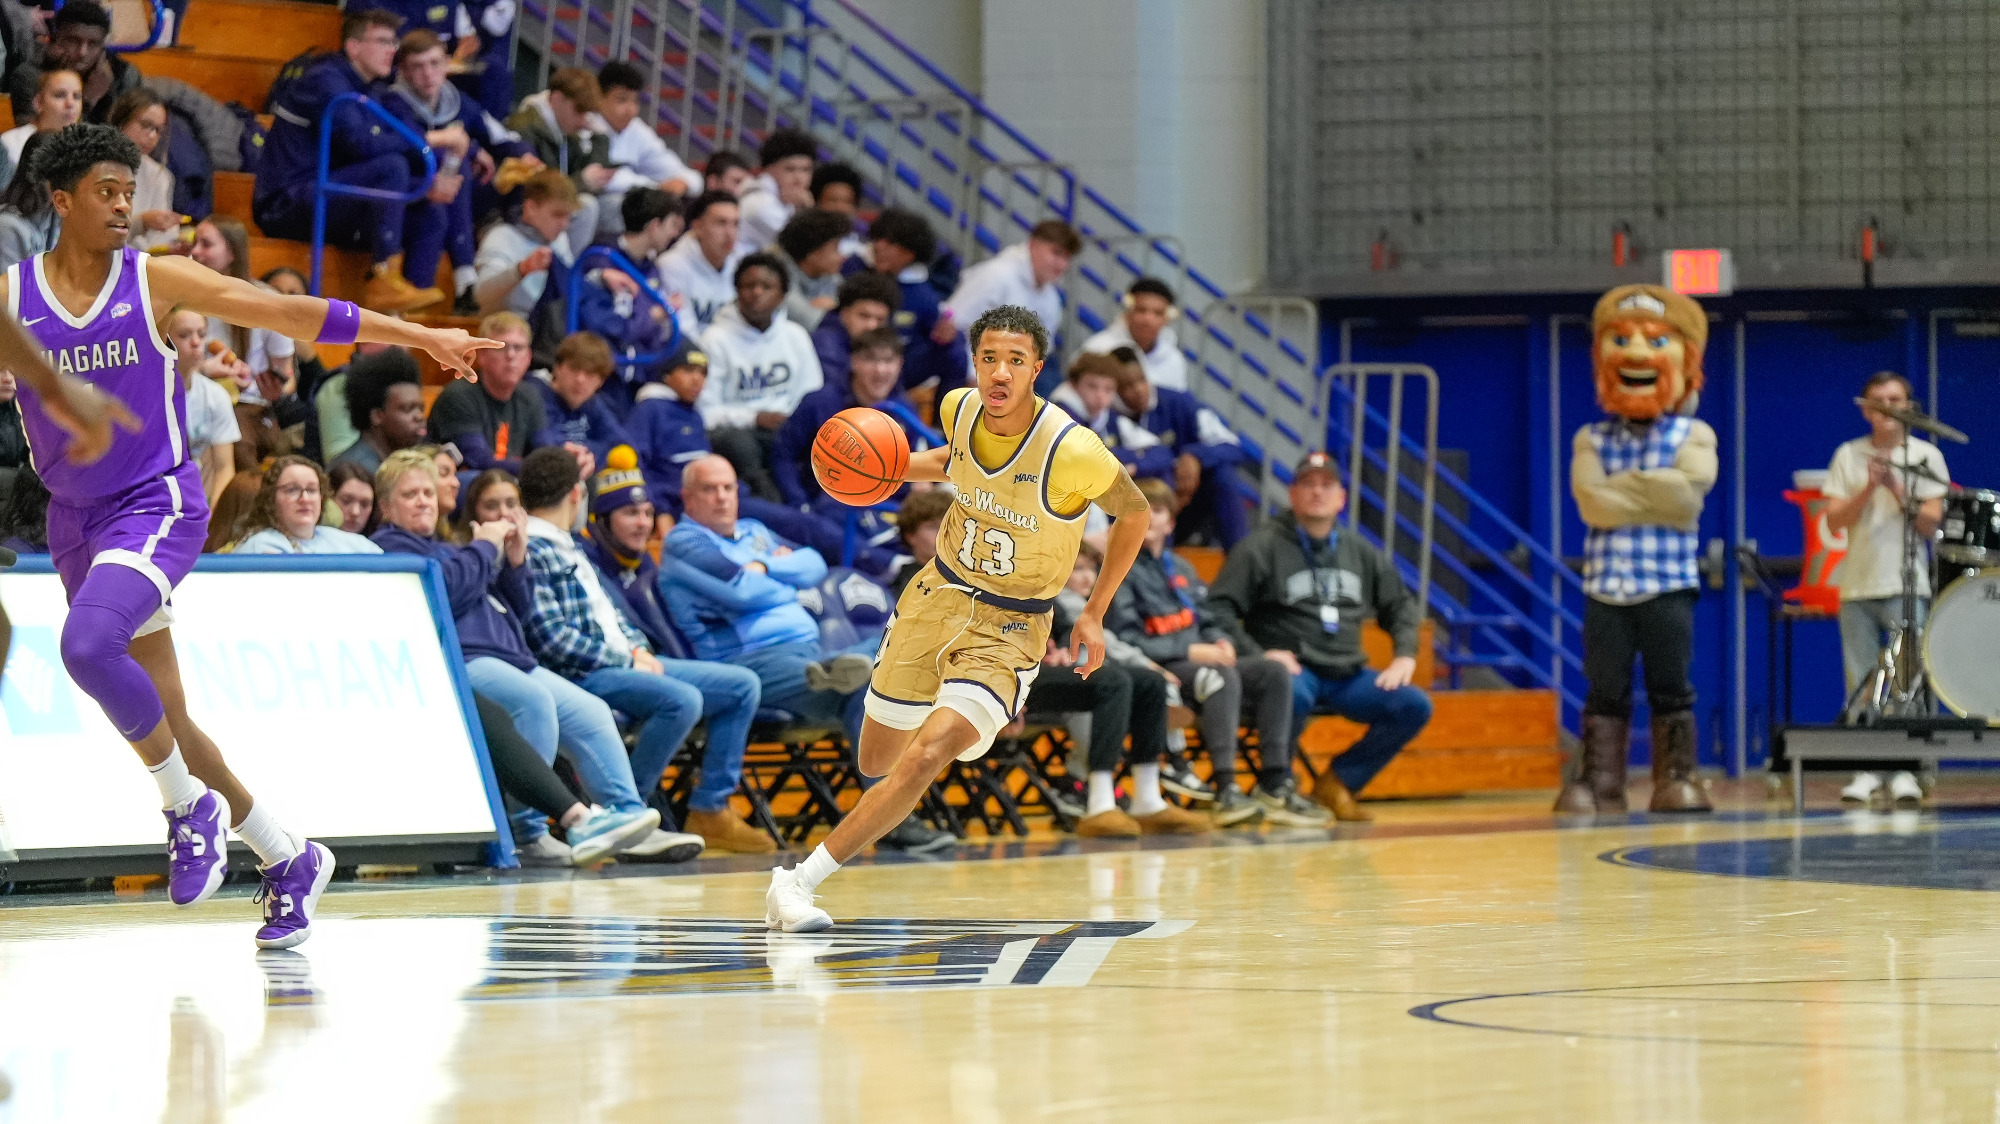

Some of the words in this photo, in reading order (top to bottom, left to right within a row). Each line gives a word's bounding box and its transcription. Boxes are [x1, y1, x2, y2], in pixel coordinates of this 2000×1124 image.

[40, 337, 140, 375] IAGARA
[831, 430, 867, 468] ROCK
[1013, 472, 1039, 485] MAAC
[975, 486, 1040, 533] Mount
[957, 517, 1016, 577] 13
[1001, 621, 1029, 635] MAAC
[174, 638, 426, 712] NDHAM
